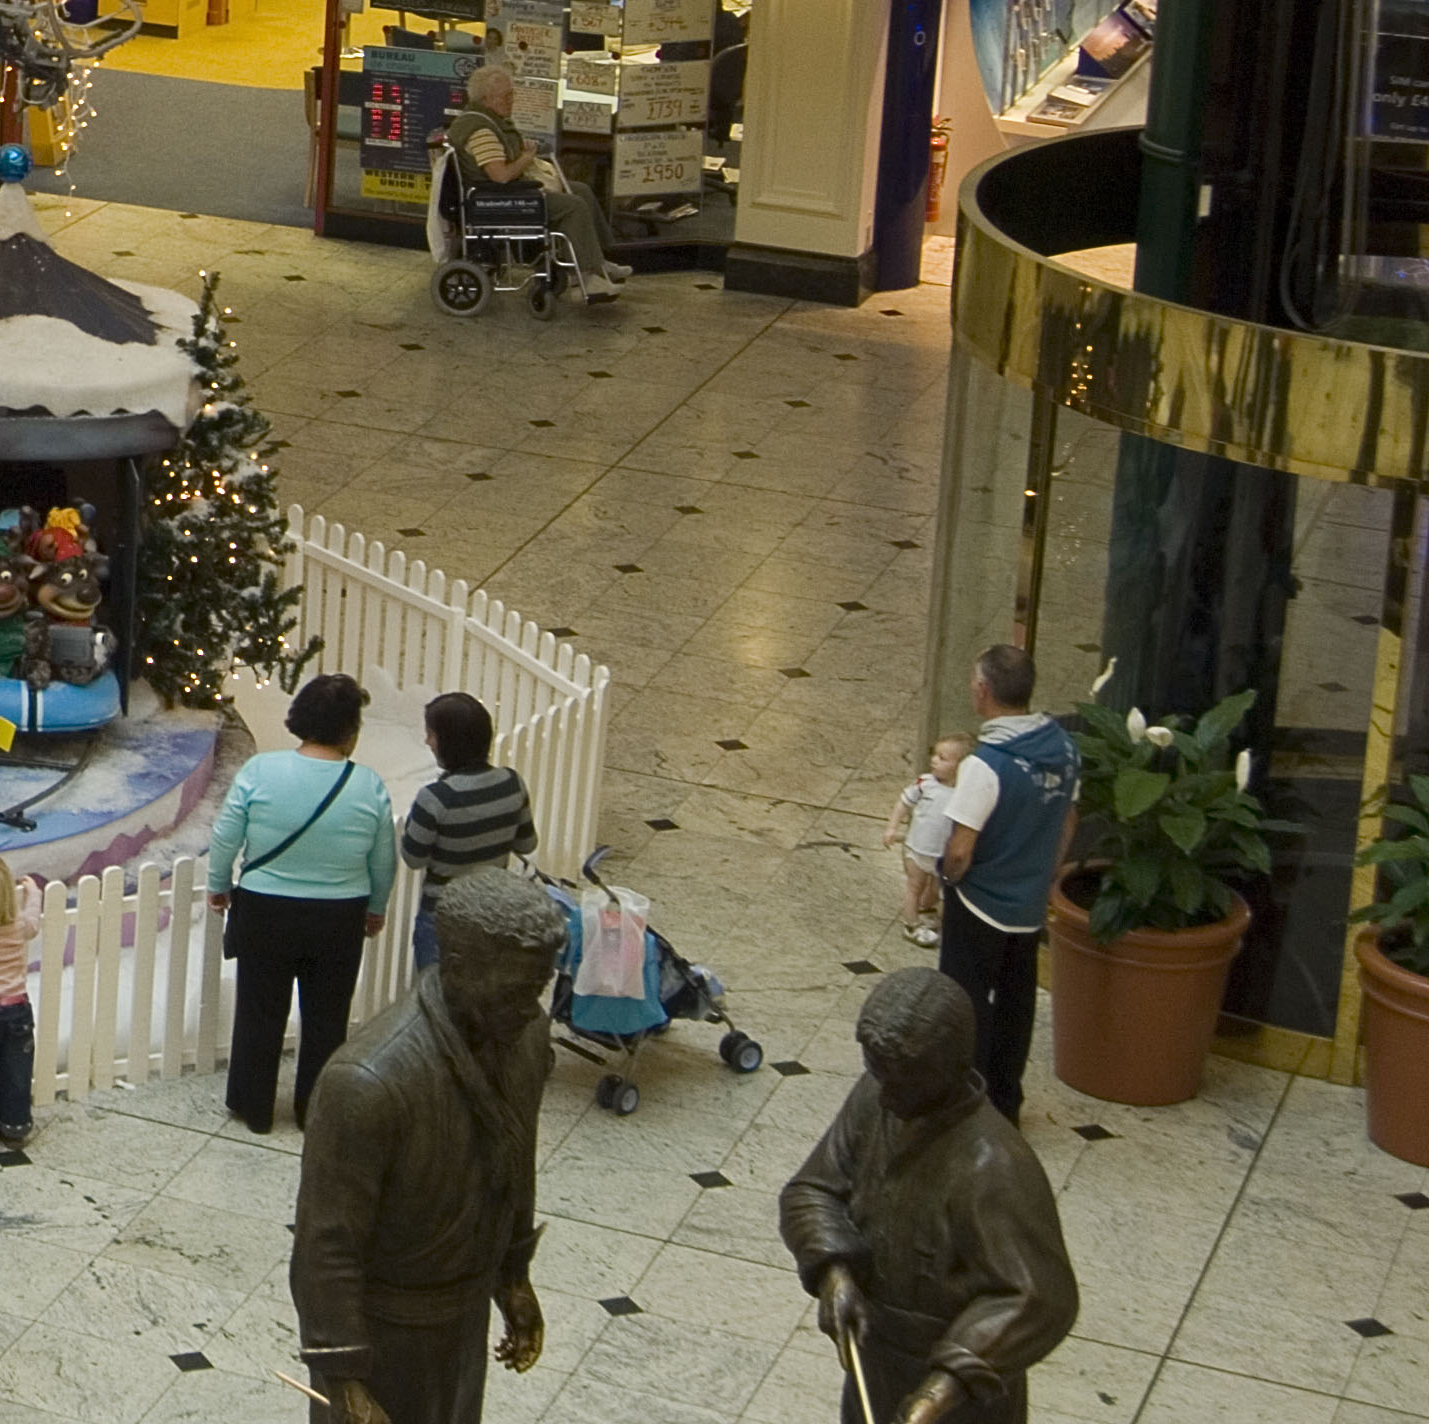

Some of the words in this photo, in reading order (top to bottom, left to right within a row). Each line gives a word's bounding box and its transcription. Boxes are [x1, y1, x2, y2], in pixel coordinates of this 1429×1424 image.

[371, 50, 416, 62] BUREAU
[365, 169, 416, 181] WESTERN
[380, 178, 415, 190] UNION
